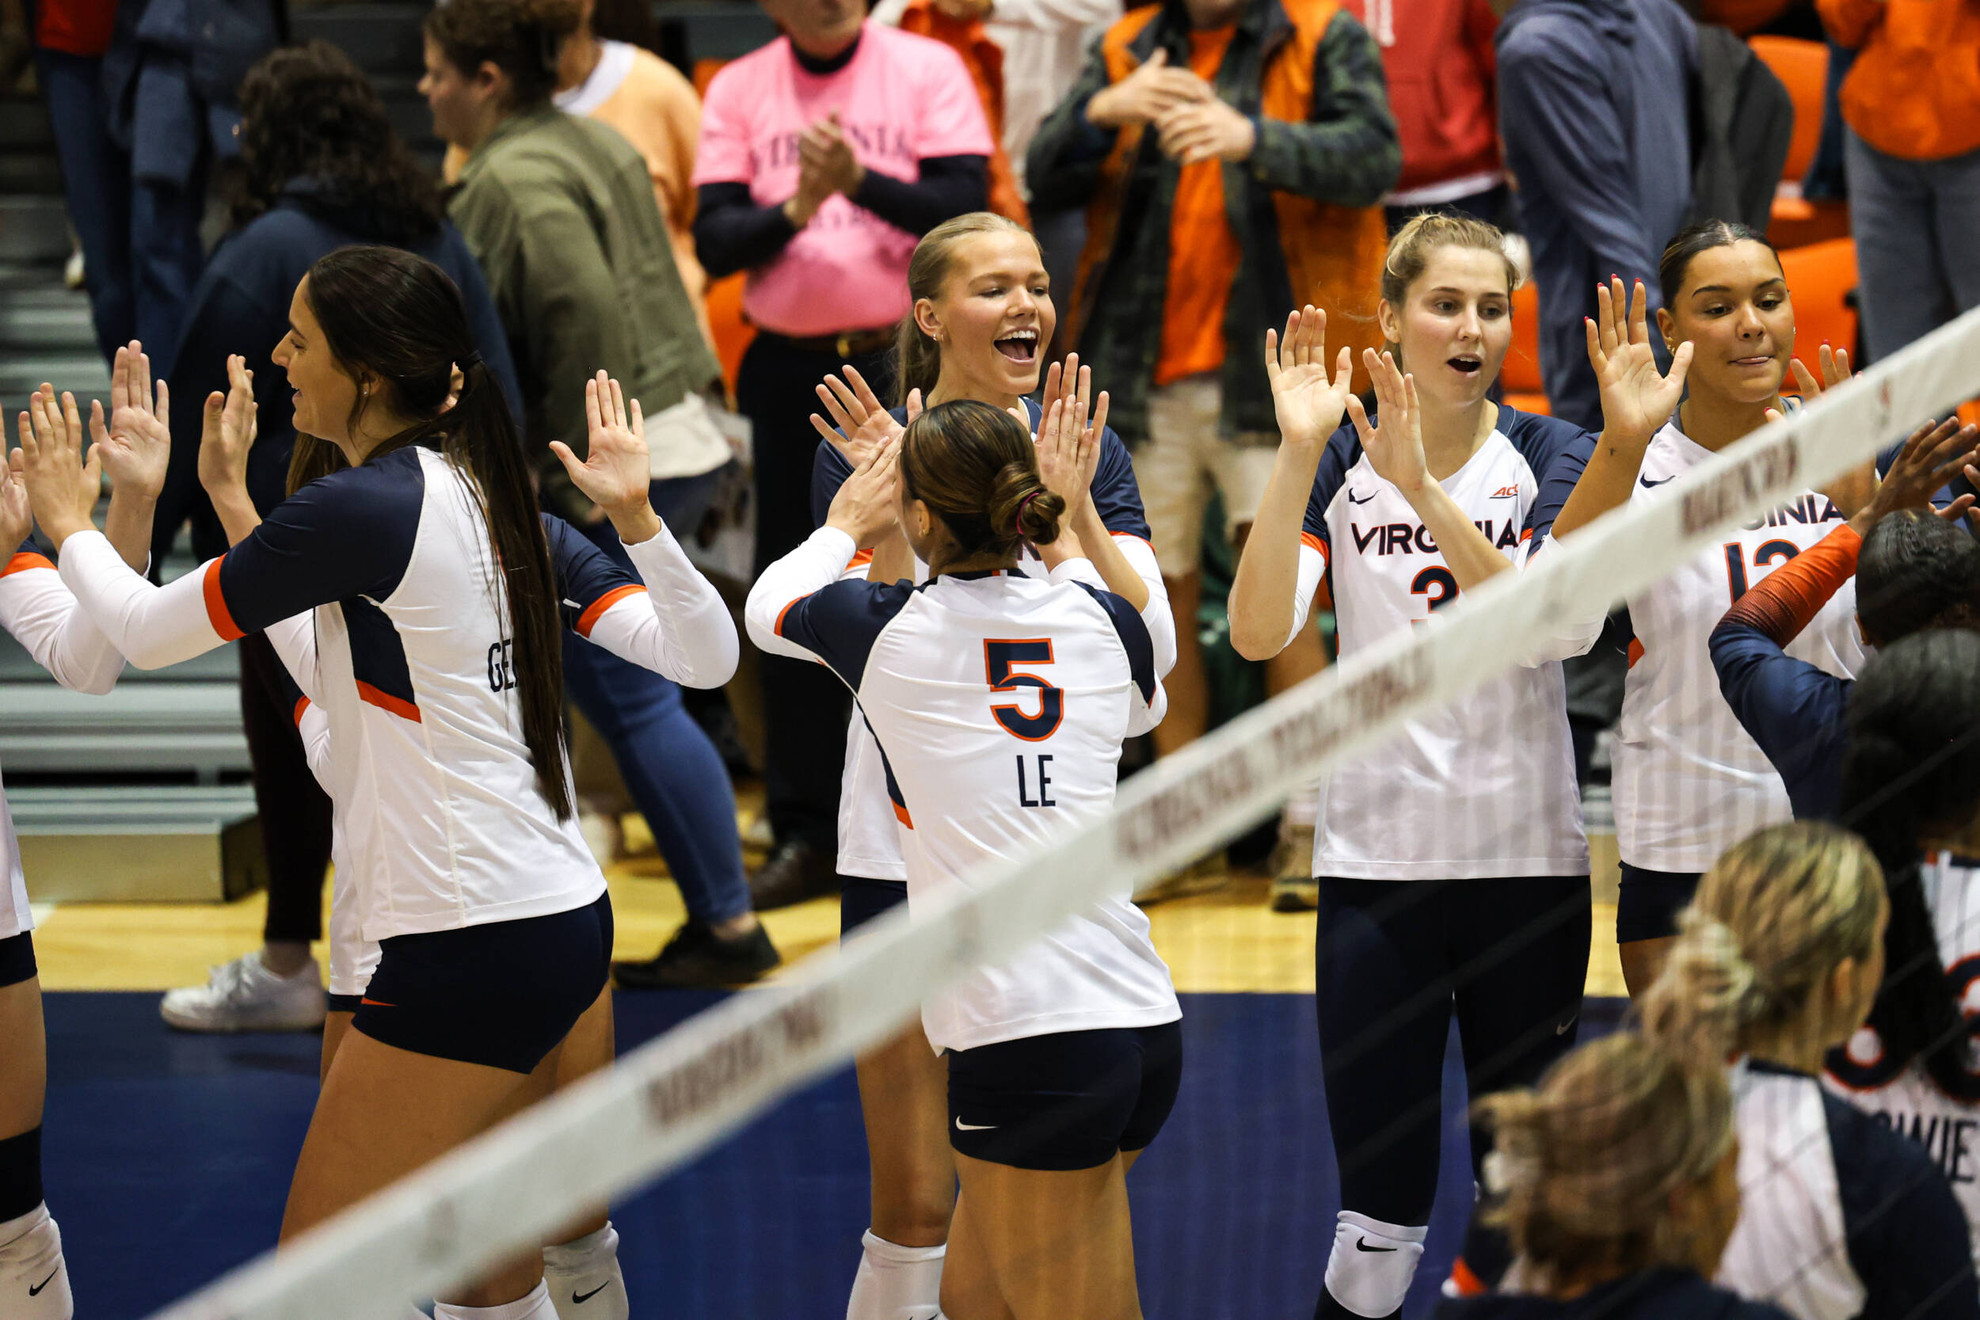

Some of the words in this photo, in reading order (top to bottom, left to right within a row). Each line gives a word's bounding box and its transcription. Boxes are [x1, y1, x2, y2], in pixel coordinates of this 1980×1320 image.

[1351, 518, 1518, 556] VIRGIA
[983, 638, 1064, 742] 5
[1016, 755, 1056, 807] LE
